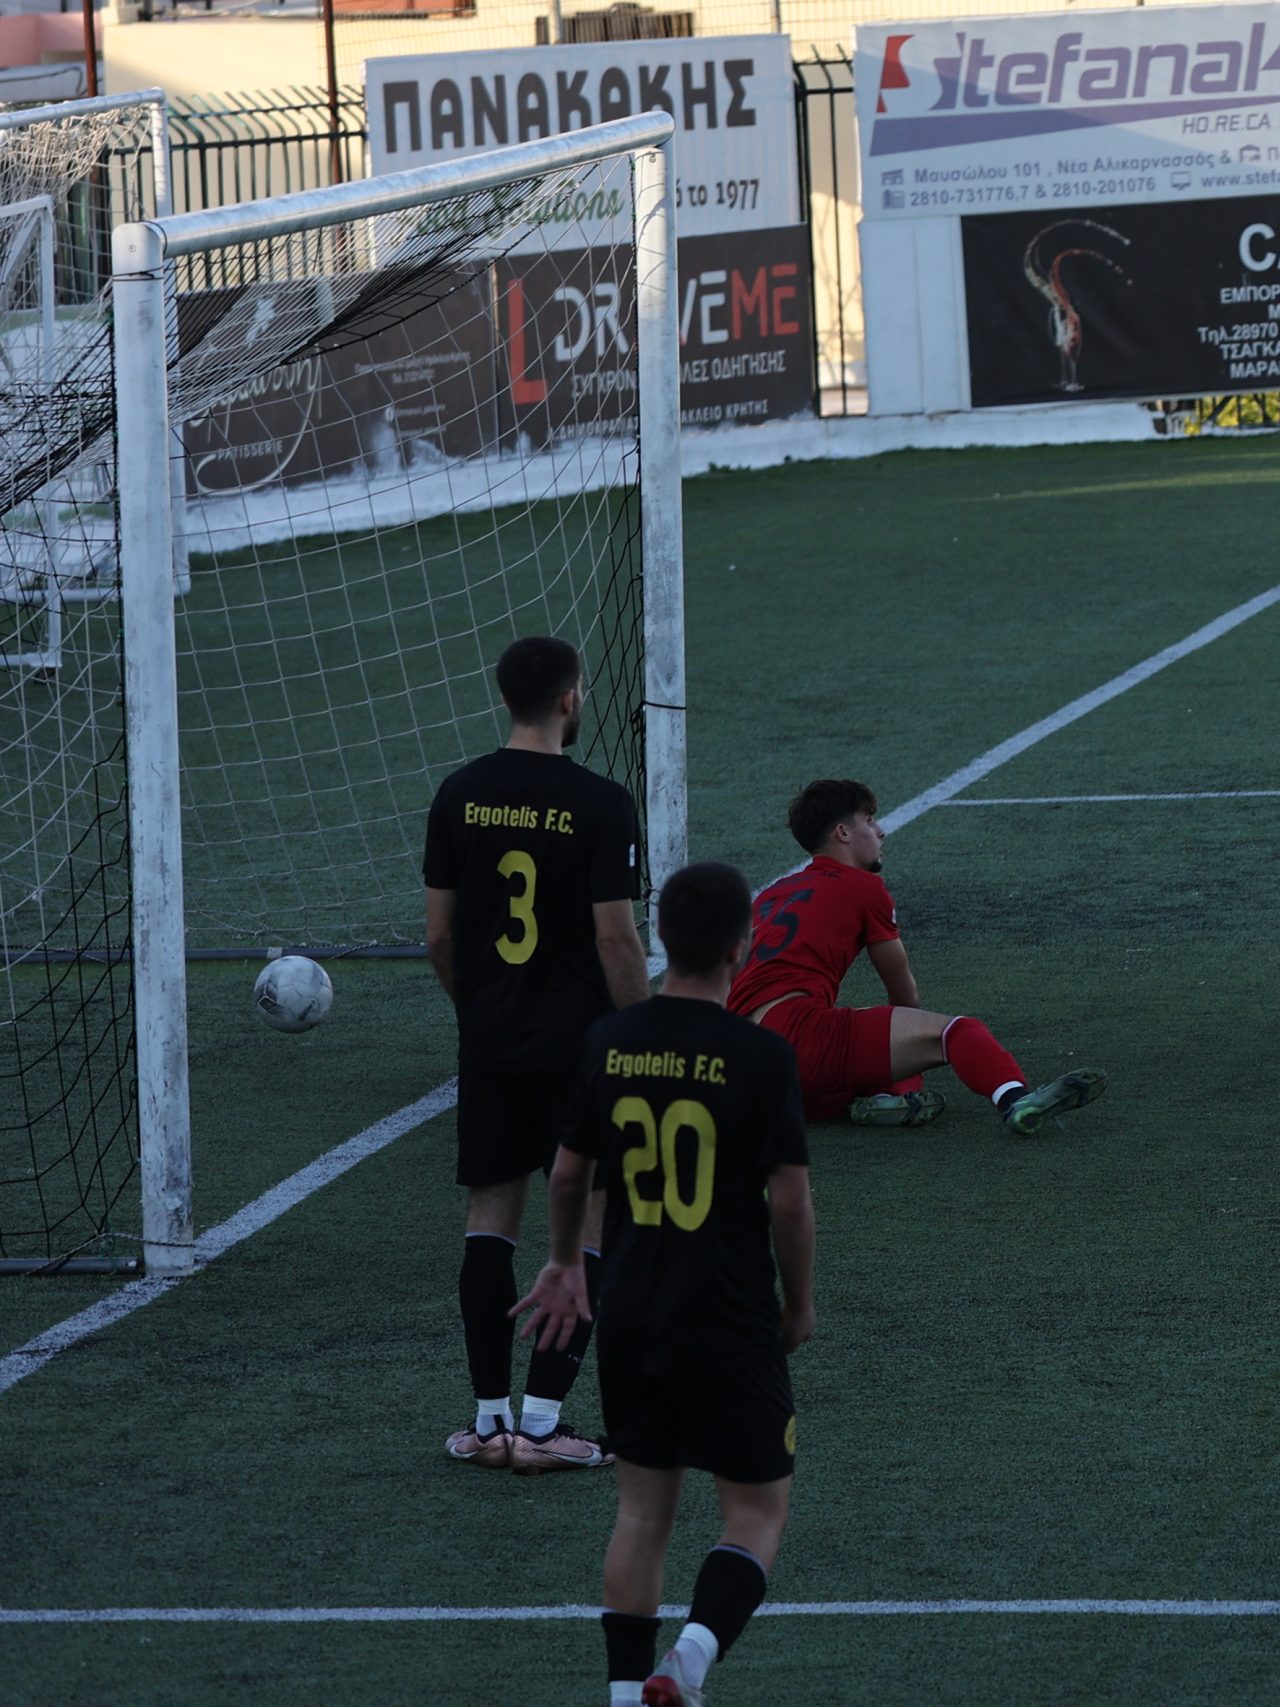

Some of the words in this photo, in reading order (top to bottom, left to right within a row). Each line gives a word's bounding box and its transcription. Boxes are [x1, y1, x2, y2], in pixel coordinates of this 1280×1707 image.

[383, 58, 757, 154] ΠΑΝΑΚΑΚΗΣ
[914, 165, 1007, 184] Μαυσώλου
[1013, 162, 1041, 178] 101
[1058, 160, 1087, 175] Νέα
[1093, 151, 1215, 173] Αλικαρνασσός
[1220, 150, 1231, 164] &
[715, 178, 760, 210] 1977
[1035, 185, 1046, 199] &
[1052, 176, 1156, 198] 2810-201076
[712, 350, 786, 382] ΟΔΗΓΗΣΗΣ
[680, 404, 722, 427] ΑΚΛΕΙΟ
[726, 399, 768, 420] ΚΡΗΤΗΣ
[465, 802, 538, 829] Ergotelis
[545, 808, 574, 834] F.C.
[495, 850, 539, 965] 3
[605, 1049, 686, 1078] Ergotelis
[693, 1055, 727, 1085] F.C.
[612, 1096, 717, 1232] 20
